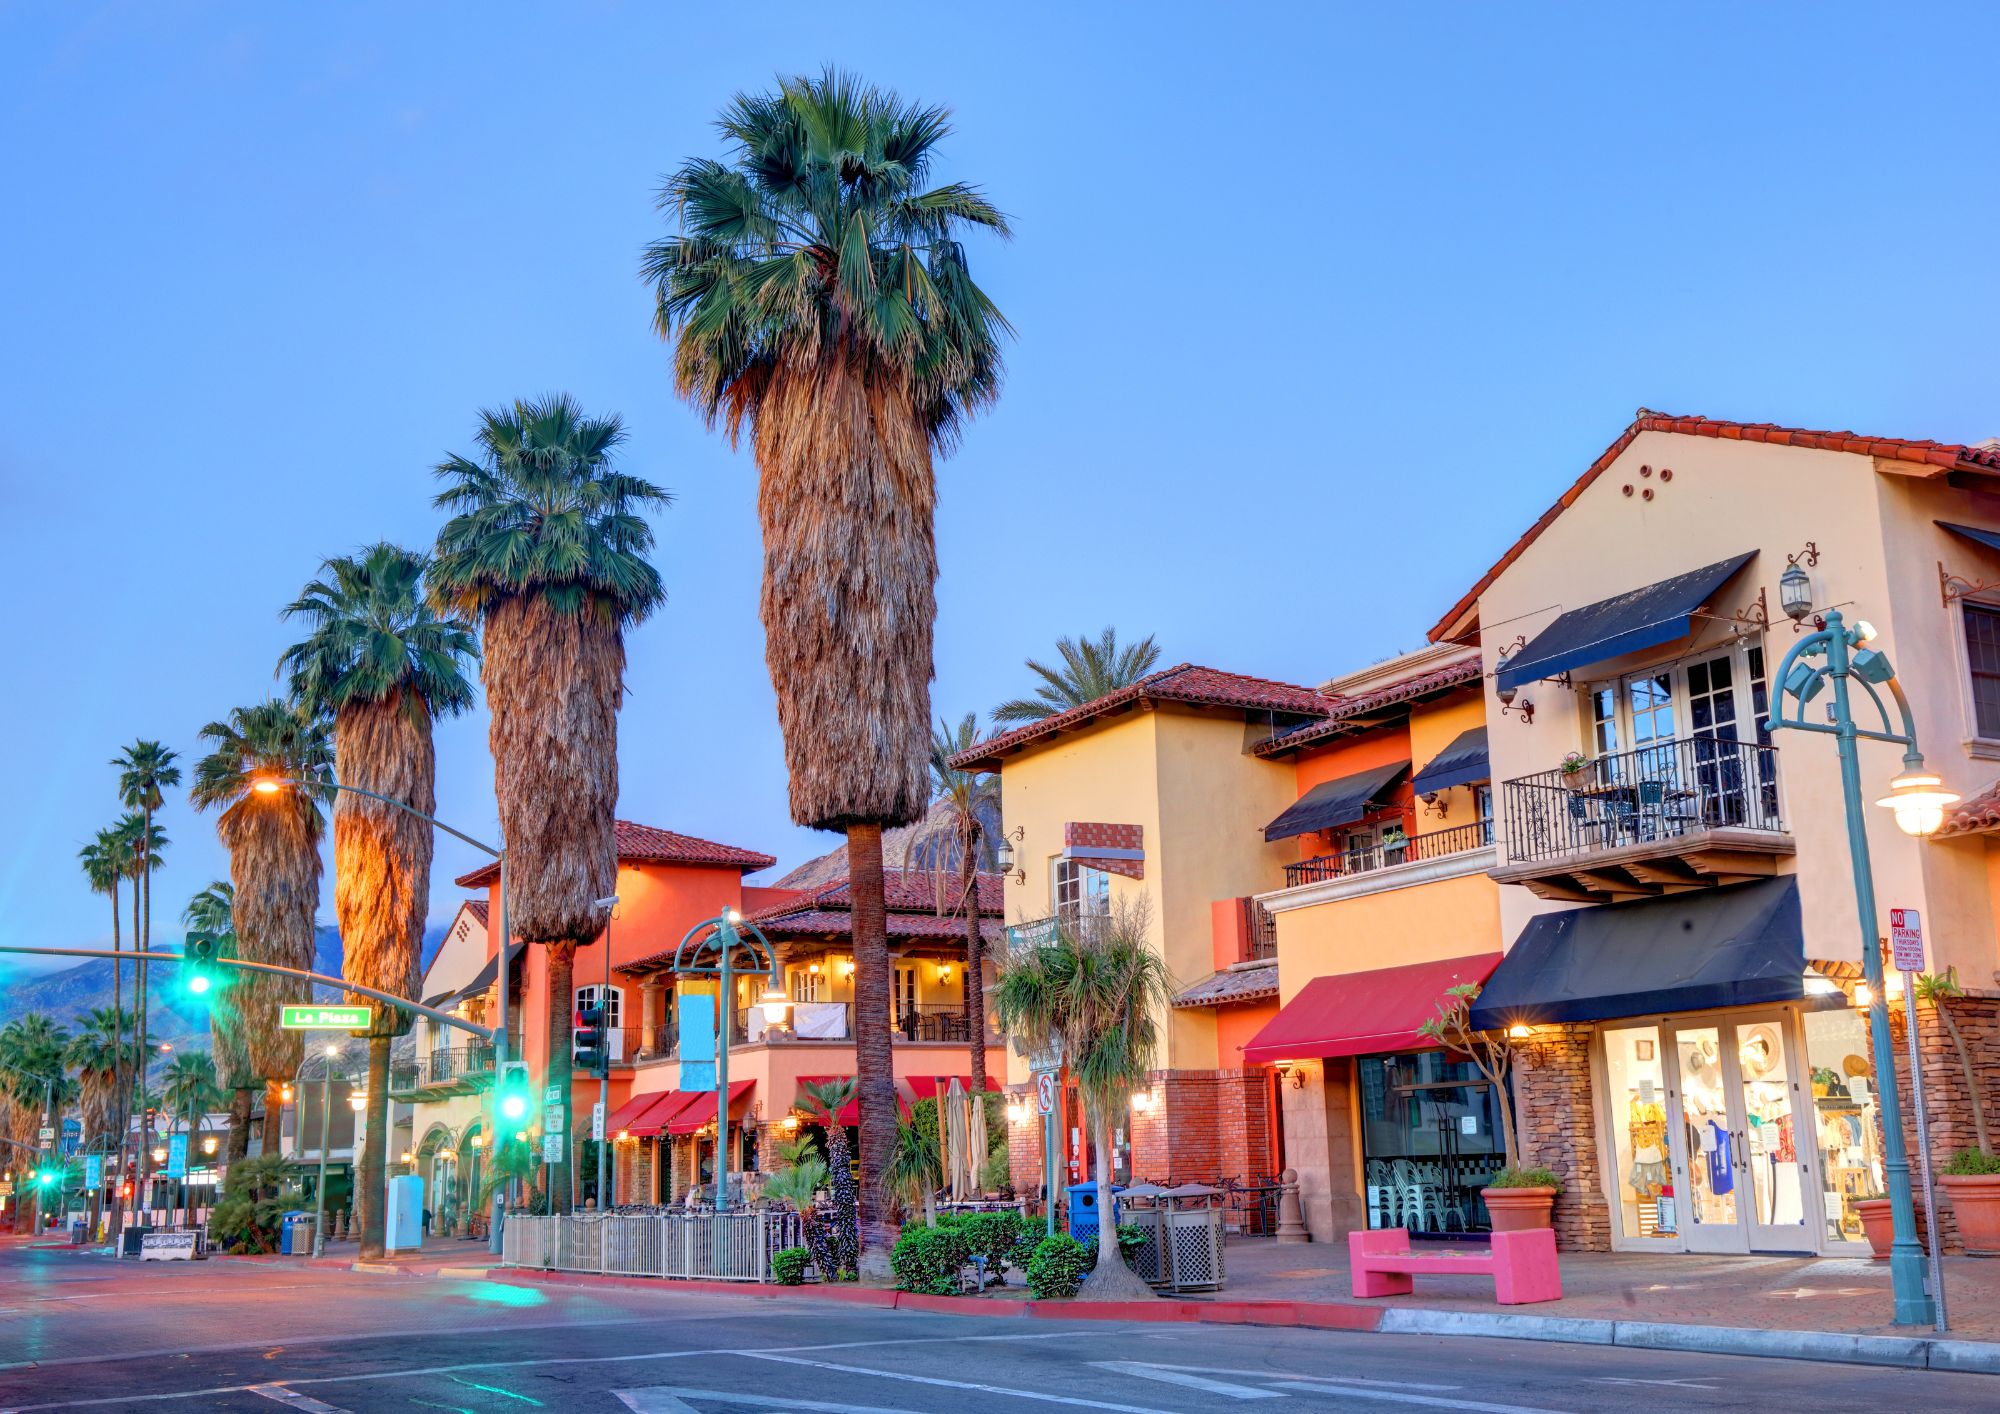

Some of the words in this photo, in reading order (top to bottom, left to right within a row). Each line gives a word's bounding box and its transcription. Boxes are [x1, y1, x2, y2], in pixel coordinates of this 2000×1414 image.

[1892, 911, 1903, 925] NO
[1894, 928, 1919, 939] PARKING
[294, 1011, 313, 1024] La
[319, 1011, 359, 1024] Plaza
